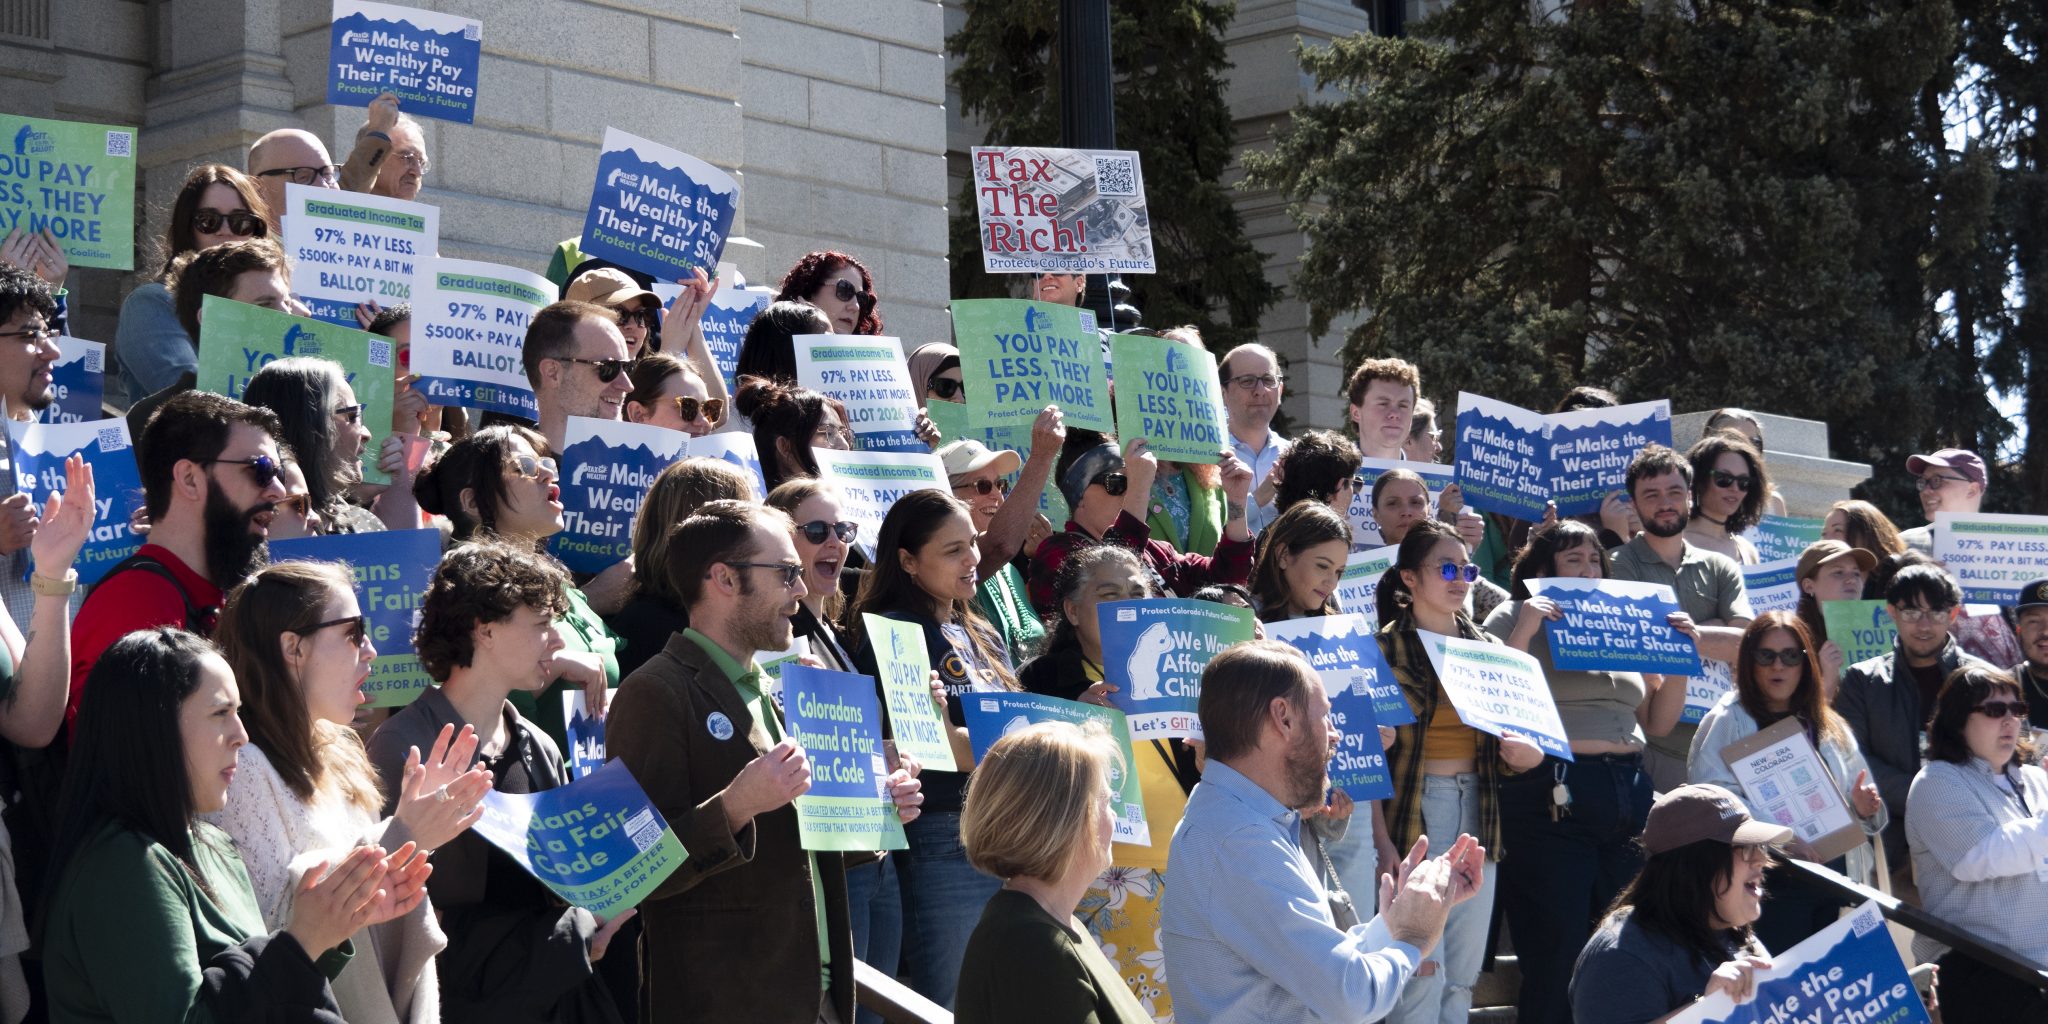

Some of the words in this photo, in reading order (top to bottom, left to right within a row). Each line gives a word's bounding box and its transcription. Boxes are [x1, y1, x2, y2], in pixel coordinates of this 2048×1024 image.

[372, 31, 419, 51] Make
[424, 40, 449, 57] the
[355, 47, 427, 74] Wealthy
[432, 58, 462, 81] Pay
[338, 64, 384, 82] Their
[390, 69, 422, 88] Fair
[426, 77, 473, 97] Share
[338, 82, 377, 95] Protect
[436, 97, 468, 109] Future
[39, 161, 93, 187] PAY
[978, 152, 1053, 182] Tax
[40, 188, 106, 215] THEY
[640, 176, 692, 207] Make
[697, 198, 718, 221] the
[982, 184, 1058, 217] The
[307, 203, 366, 219] Graduated
[369, 213, 406, 227] Income
[408, 218, 424, 230] Tax
[620, 191, 698, 237] Wealthy
[702, 221, 721, 251] Pay
[593, 229, 636, 250] Protect
[598, 206, 647, 237] Their
[652, 226, 690, 252] Fair
[987, 219, 1087, 253] Rich!
[315, 228, 346, 245] 97%
[354, 233, 381, 249] PAY
[385, 238, 416, 255] LESS.
[70, 248, 111, 259] Coalition
[299, 247, 344, 265] $500K+
[348, 254, 370, 268] PAY
[373, 258, 382, 270] A
[385, 259, 399, 273] BIT
[990, 258, 1034, 268] Protect
[1040, 258, 1105, 269] Colorado's
[1109, 258, 1150, 269] Future
[320, 272, 374, 292] BALLOT
[380, 281, 410, 298] 2026
[439, 276, 511, 294] Graduated
[449, 302, 487, 321] 97%
[496, 308, 522, 326] PAY
[729, 318, 749, 333] the
[425, 323, 483, 341] $500K+
[488, 331, 515, 348] PAY
[994, 334, 1042, 354] YOU
[1046, 336, 1079, 358] PAY
[452, 350, 515, 373] BALLOT
[812, 349, 855, 358] Graduated
[856, 349, 881, 358] Income
[821, 370, 846, 383] 97%
[850, 370, 869, 382] PAY
[989, 358, 1049, 380] LESS,
[1051, 360, 1090, 383] THEY
[438, 382, 471, 399] Let's
[475, 386, 496, 402] GIT
[850, 390, 869, 400] PAY
[891, 389, 911, 399] MORE
[995, 381, 1042, 403] PAY
[1048, 382, 1094, 407] MORE
[1143, 370, 1178, 393] YOU
[1182, 376, 1208, 398] PAY
[877, 407, 904, 421] 2026
[988, 410, 1017, 418] Protect
[1138, 394, 1181, 420] LESS,
[1186, 399, 1218, 422] THEY
[1143, 418, 1175, 439] PAY
[1181, 422, 1222, 444] MORE
[1483, 428, 1514, 450] Make
[1517, 439, 1534, 456] the
[1576, 435, 1619, 454] Make
[1623, 431, 1646, 446] the
[832, 465, 879, 476] Graduated
[881, 467, 916, 477] Income
[918, 468, 933, 478] Tax
[1472, 444, 1519, 475] Wealthy
[1521, 461, 1542, 481] Pay
[1562, 452, 1630, 473] Wealthy
[586, 473, 608, 481] WEALTHY
[609, 463, 653, 488] Make
[1460, 460, 1490, 482] Their
[1493, 471, 1515, 489] Fair
[1517, 476, 1549, 498] Share
[1551, 474, 1594, 492] Their
[845, 487, 869, 502] 97%
[1458, 480, 1484, 497] Protect
[1484, 487, 1522, 506] Colorado's
[1523, 496, 1545, 510] Future
[1553, 488, 1590, 504] Protect
[563, 512, 623, 538] Their
[1952, 523, 2001, 532] Graduated
[2004, 524, 2039, 533] Income
[558, 537, 612, 556] Protect
[1761, 531, 1783, 547] We
[1957, 540, 1984, 550] 97%
[1990, 541, 2015, 551] PAY
[85, 545, 141, 563] Future
[1373, 559, 1390, 570] Tax
[1984, 555, 2005, 564] PAY
[2017, 557, 2032, 565] BIT
[1777, 572, 1794, 583] Tax
[1960, 569, 2008, 580] BALLOT
[1766, 591, 1793, 602] THAT
[1141, 607, 1171, 616] Protect
[1171, 606, 1205, 617] Colorado's
[1574, 599, 1622, 615] Make
[1625, 604, 1652, 618] the
[1564, 613, 1636, 636] Wealthy
[1639, 620, 1671, 639] Pay
[1852, 629, 1885, 646] YOU
[1172, 630, 1201, 650] We
[1553, 630, 1599, 646] Their
[1603, 633, 1637, 648] Fair
[1642, 636, 1693, 653] Share
[1337, 645, 1359, 662] the
[1486, 654, 1518, 666] Income
[1559, 648, 1598, 658] Protect
[1600, 649, 1656, 661] Colorado's
[1658, 653, 1692, 664] Future
[387, 679, 410, 690] FOR
[1479, 670, 1503, 683] PAY
[1481, 686, 1500, 697] PAY
[798, 691, 863, 722] Coloradans
[1003, 700, 1029, 710] Protect
[914, 720, 940, 743] MORE
[1134, 718, 1167, 732] Let's
[1171, 717, 1189, 729] GIT
[793, 722, 840, 751] Demand
[841, 735, 849, 751] a
[851, 727, 875, 754] Fair
[1337, 751, 1383, 771] Share
[1750, 757, 1767, 769] NEW
[1776, 746, 1791, 757] ERA
[1754, 752, 1794, 775] COLORADO
[809, 755, 831, 782] Tax
[833, 757, 864, 784] Code
[1352, 773, 1383, 786] Future
[830, 805, 850, 816] INCOME
[547, 837, 567, 853] a
[569, 806, 630, 848] Fair
[813, 822, 832, 832] SYSTEM
[832, 822, 847, 832] THAT
[848, 822, 870, 832] WORKS
[534, 851, 608, 876] Code
[613, 874, 624, 889] A
[623, 843, 665, 880] BETTER
[623, 875, 647, 896] FOR
[650, 855, 669, 875] ALL
[1801, 965, 1843, 998] the
[1824, 972, 1874, 1012] Pay
